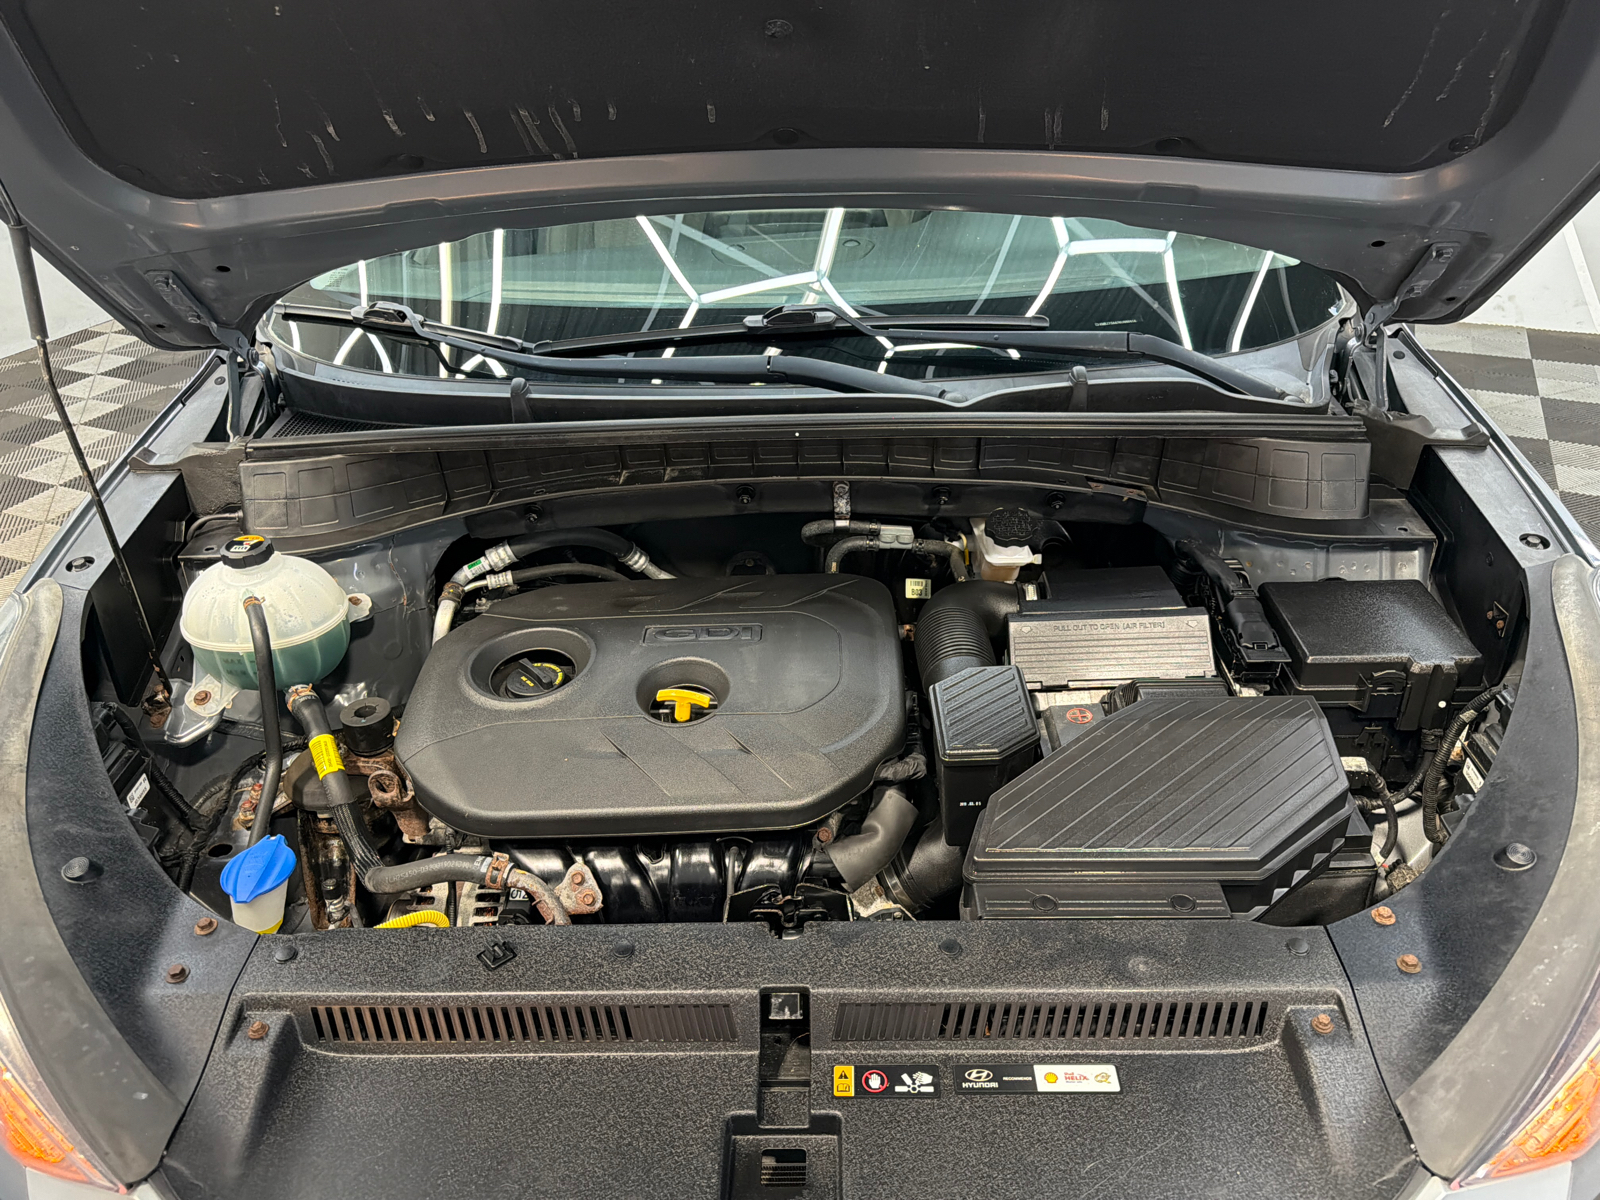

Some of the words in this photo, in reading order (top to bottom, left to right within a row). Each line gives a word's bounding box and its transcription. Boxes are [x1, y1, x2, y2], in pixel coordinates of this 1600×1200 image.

[1089, 623, 1099, 631] TO
[1100, 622, 1120, 630] OPEN
[654, 627, 752, 642] GDI
